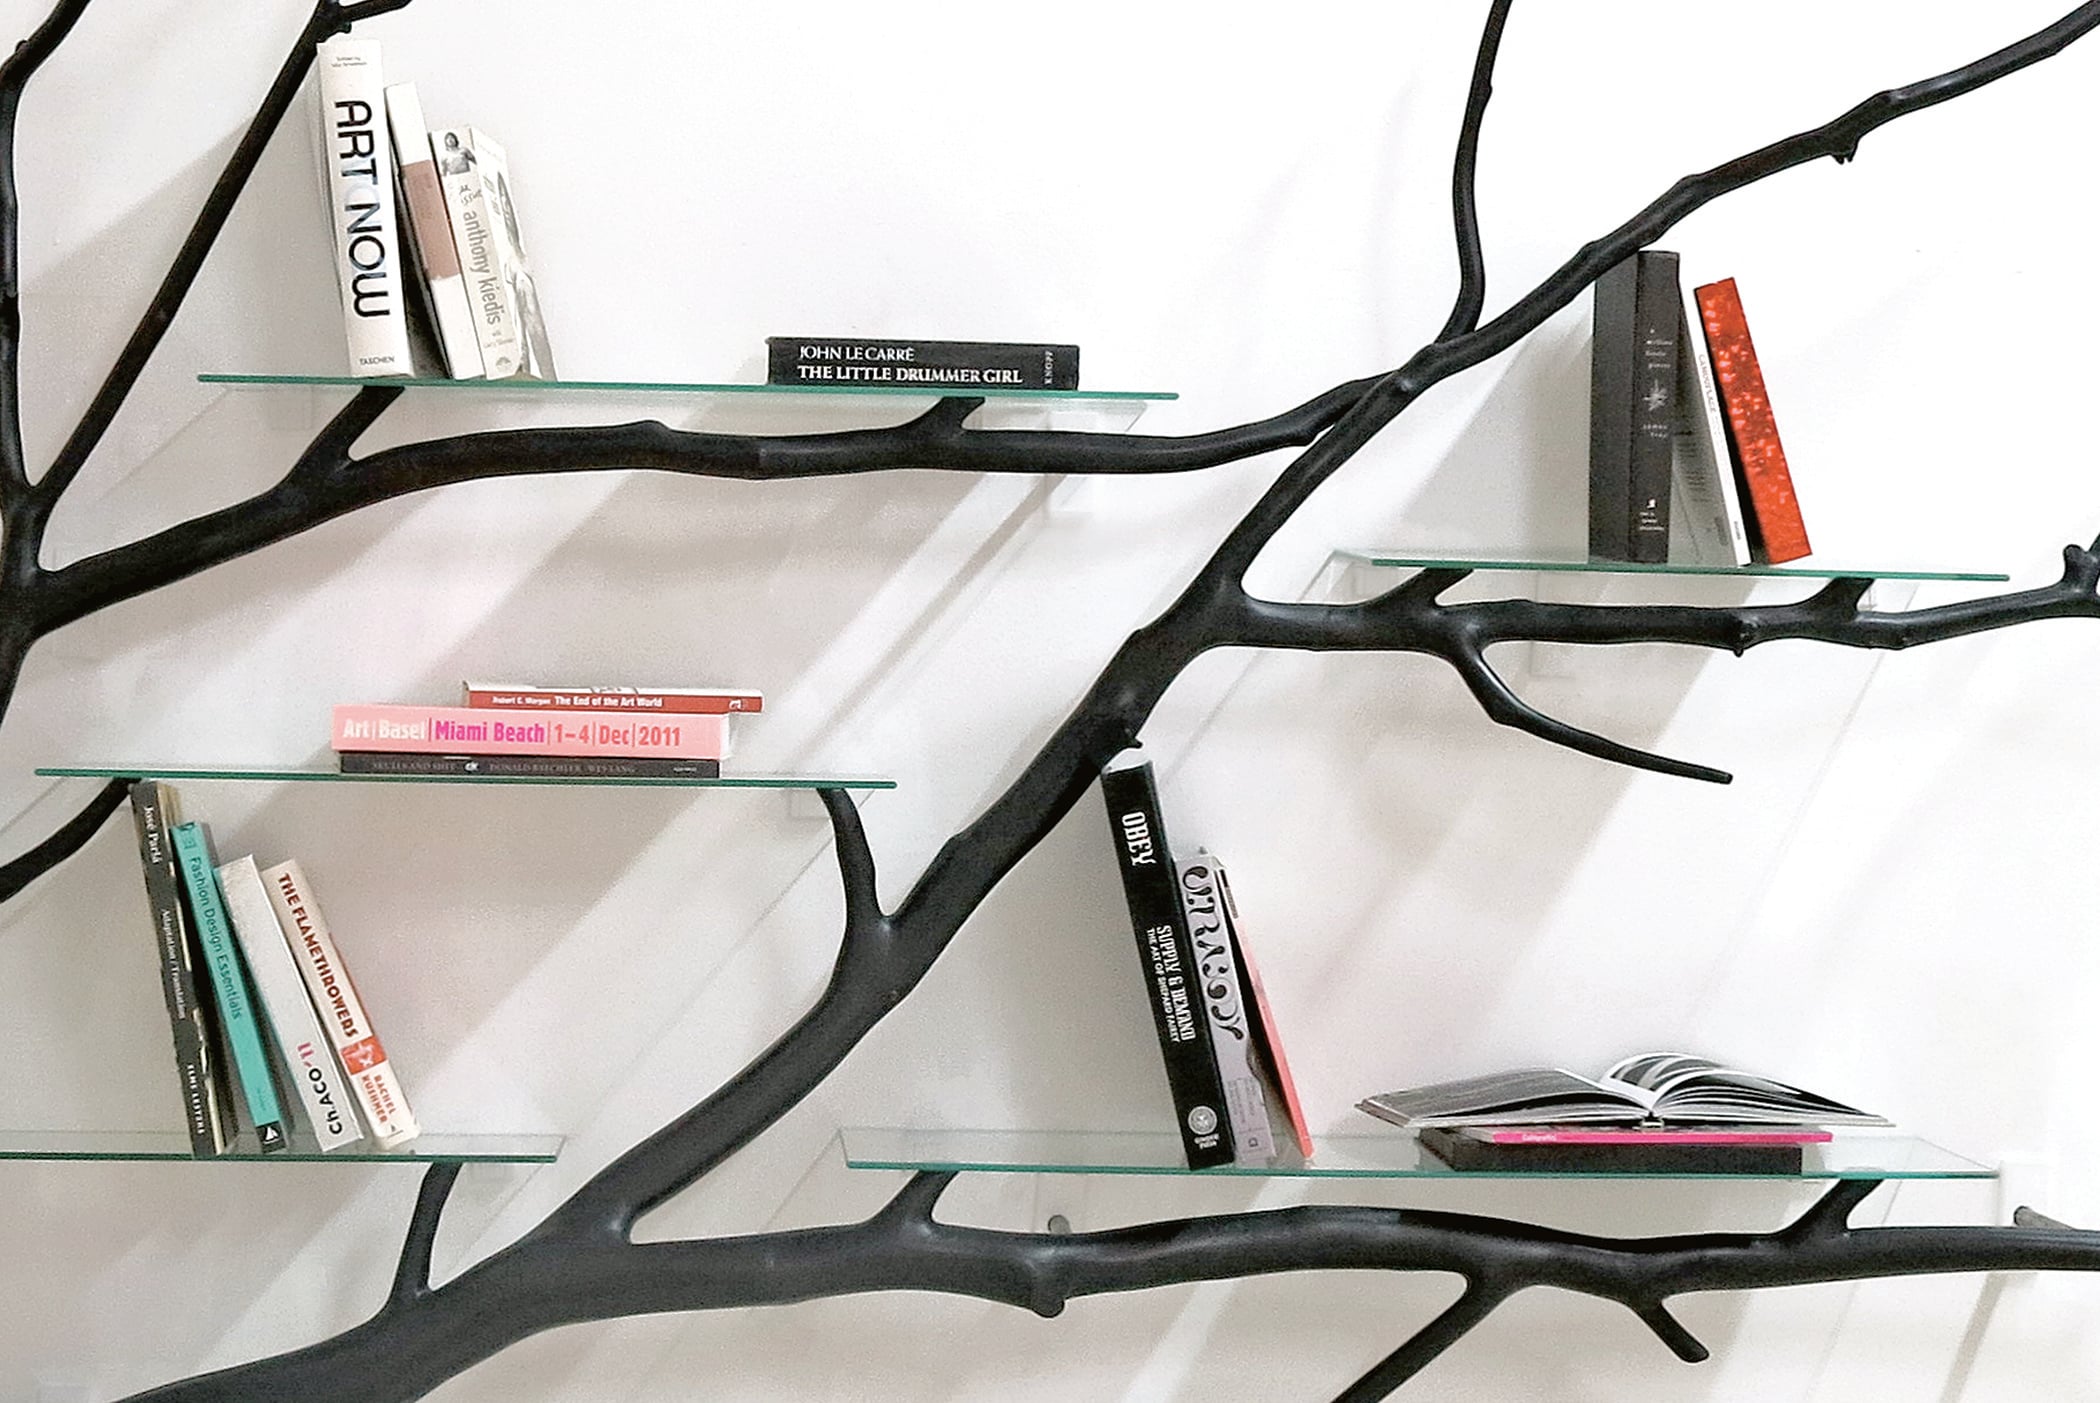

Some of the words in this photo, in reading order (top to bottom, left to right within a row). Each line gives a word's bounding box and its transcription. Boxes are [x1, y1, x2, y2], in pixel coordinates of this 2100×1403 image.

[334, 100, 379, 185] ART
[345, 202, 391, 318] NOW
[462, 210, 490, 274] anthony
[478, 274, 505, 325] kiedis
[359, 356, 395, 366] TASCHEN
[800, 345, 841, 360] JOHN
[846, 346, 864, 360] LE
[797, 365, 833, 379] THE
[836, 366, 892, 380] LITTLE
[896, 367, 981, 382] DRUMMER
[982, 369, 1023, 383] GIRL
[555, 695, 571, 706] The
[574, 696, 589, 706] End
[592, 696, 602, 706] of
[604, 697, 620, 707] the
[621, 698, 634, 707] Art
[637, 697, 663, 708] World
[343, 718, 370, 739] Art
[378, 719, 425, 740] Basel
[435, 720, 487, 741] Miami
[493, 721, 545, 743] Beach
[600, 725, 630, 745] Dec
[638, 726, 681, 747] 2011
[1121, 811, 1157, 867] OBEY
[190, 856, 209, 907] Fashion
[204, 908, 222, 953] Design
[216, 954, 242, 1020] Essentials
[1146, 928, 1158, 944] THE
[1150, 944, 1162, 961] ART
[1156, 924, 1182, 973] SUPPLY
[278, 872, 301, 906] THE
[291, 906, 359, 1038] FLAMETHROWERS
[1154, 962, 1165, 976] OF
[1167, 975, 1183, 986] &
[1169, 986, 1196, 1041] DEMAND
[373, 1074, 396, 1115] RACHEL
